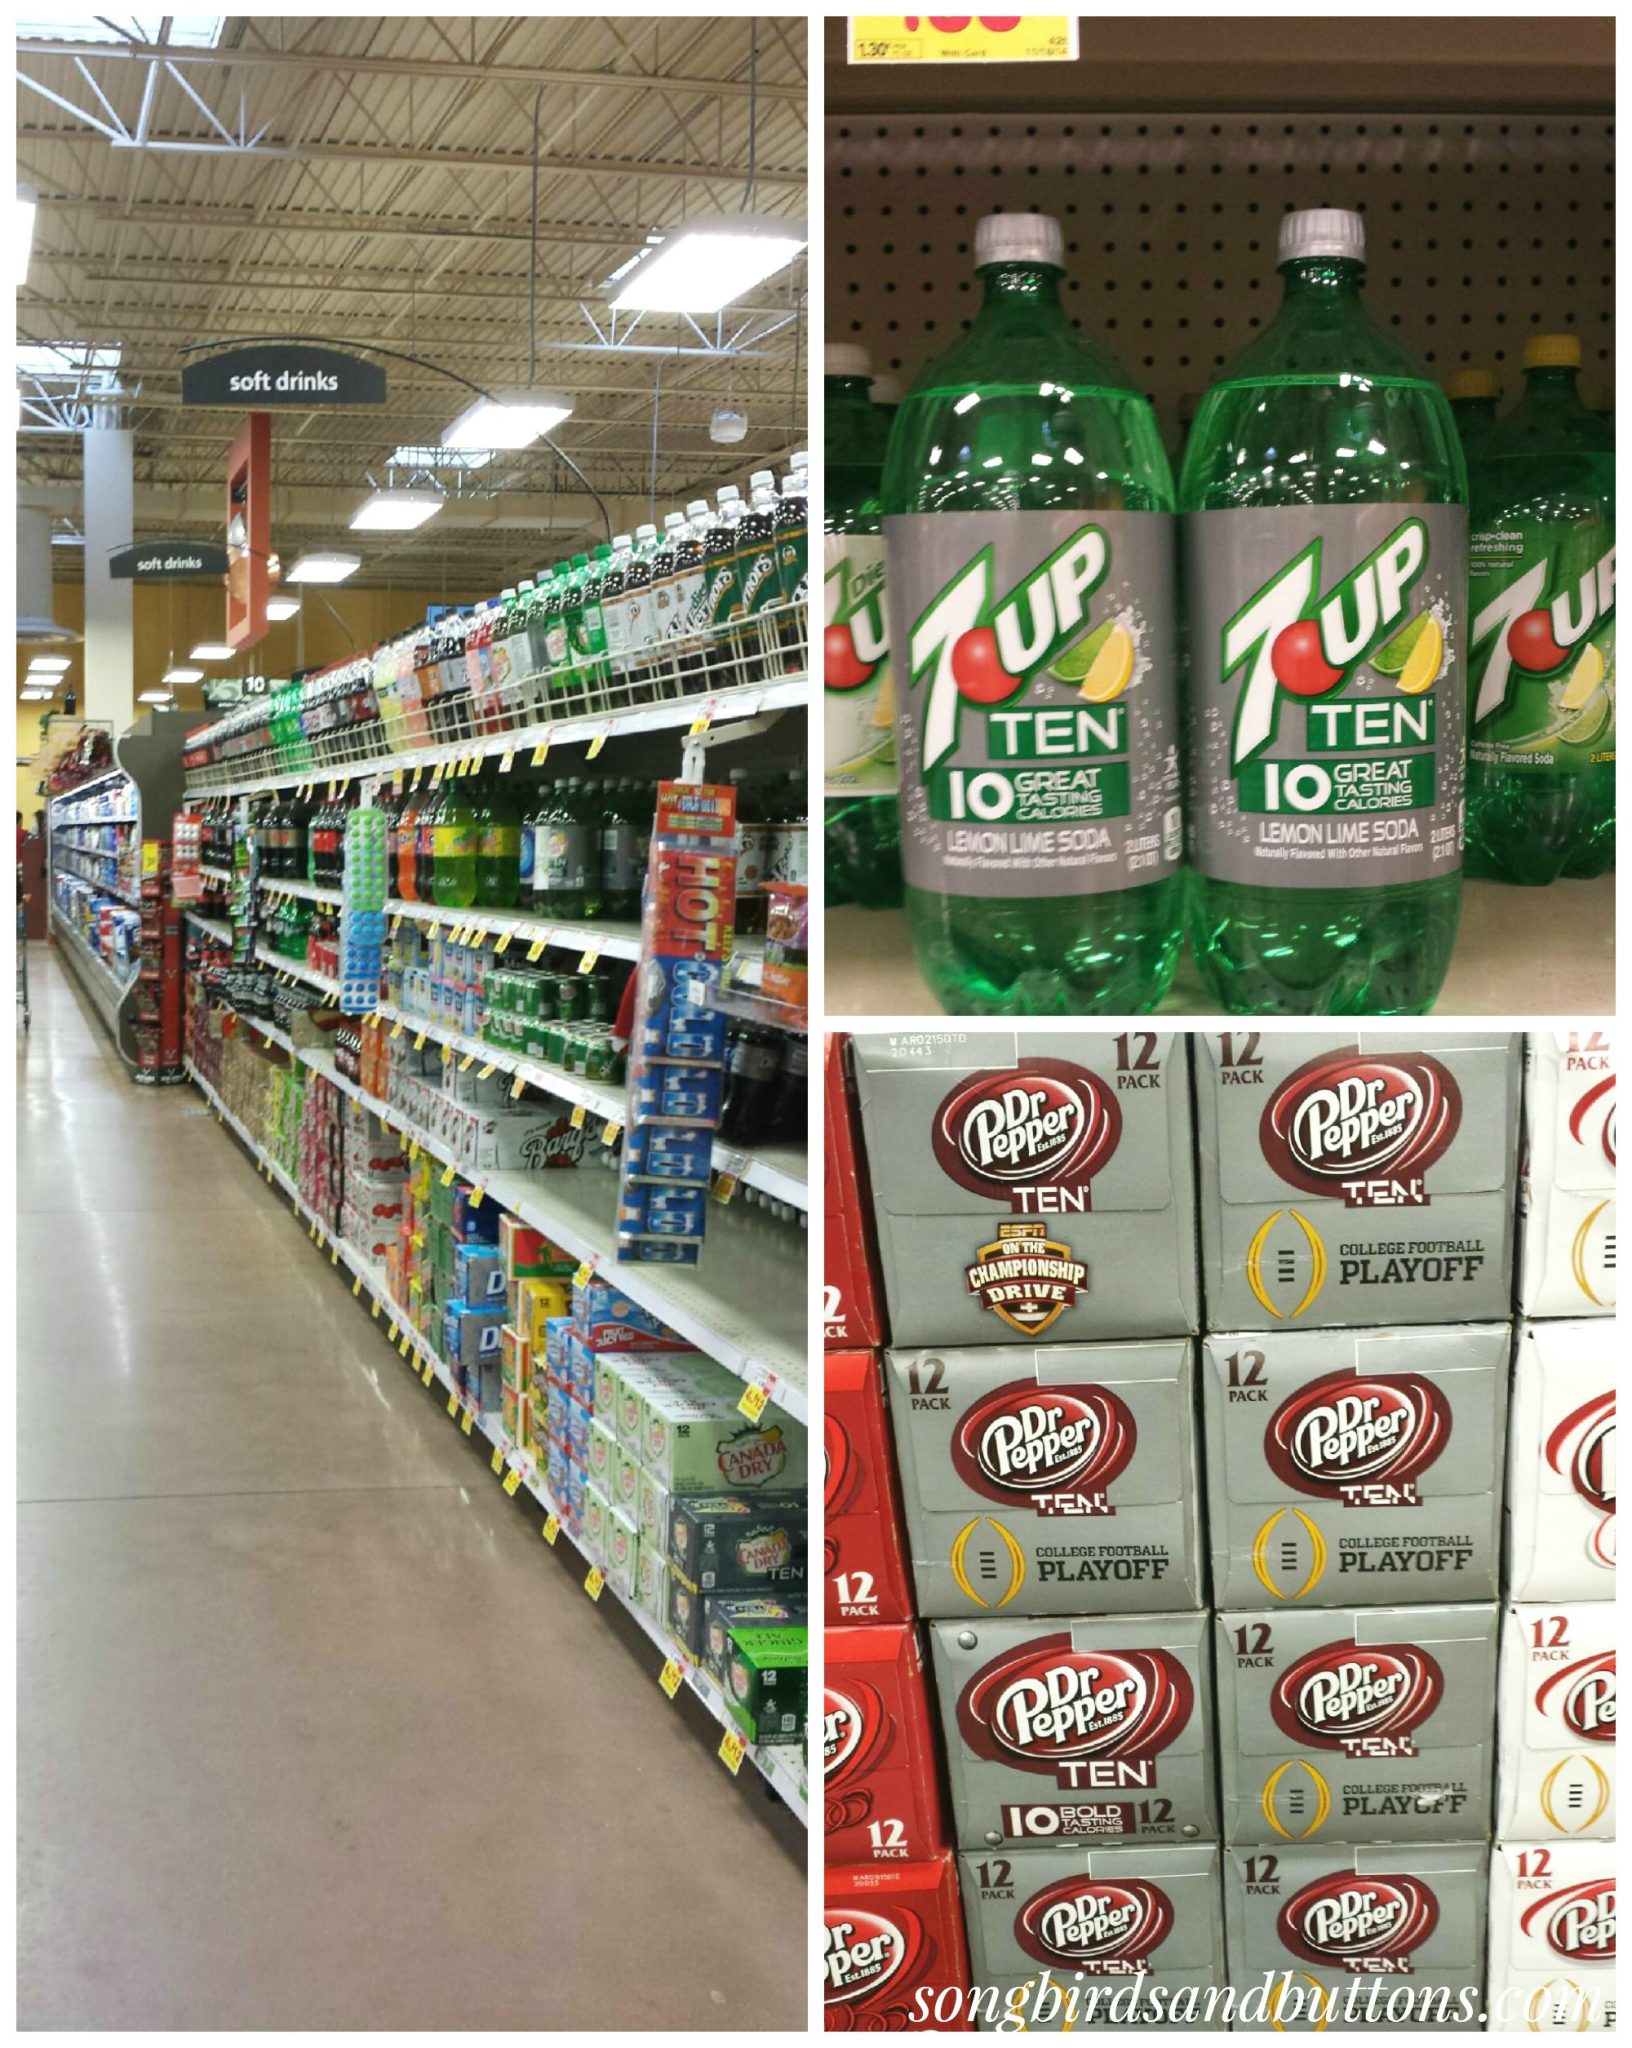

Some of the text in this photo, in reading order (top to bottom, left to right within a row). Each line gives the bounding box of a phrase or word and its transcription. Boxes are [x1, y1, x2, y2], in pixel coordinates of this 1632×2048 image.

[229, 369, 339, 393] soft drinks
[1470, 542, 1524, 554] refreshing
[136, 555, 202, 572] soft drinks
[852, 560, 884, 594] Die
[245, 676, 265, 693] 10
[989, 707, 1119, 756] TEN
[1310, 699, 1427, 747] TEN
[1500, 752, 1533, 764] Flavored
[1534, 752, 1555, 765] Soda
[1015, 768, 1102, 792] GREAT
[1333, 759, 1412, 783] GREAT
[949, 770, 1015, 821] 10
[1015, 788, 1102, 807] TASTING
[1264, 763, 1332, 811] 10
[1334, 780, 1412, 798] TASTING
[1016, 804, 1103, 821] CALORIES
[1334, 795, 1413, 812] CALORIES
[946, 827, 1112, 854] LEMON LIME SODA
[1259, 818, 1420, 844] LEMON LIME SODA
[1254, 842, 1424, 860] Naturally Flavored With Other Natural Flavors
[673, 856, 721, 951] HOT
[1112, 1032, 1160, 1071] 12
[1217, 1032, 1264, 1068] 12
[1567, 1056, 1610, 1071] PACK
[1116, 1074, 1161, 1090] PACK
[1221, 1070, 1265, 1086] PACK
[1002, 1089, 1046, 1127] Dr
[1339, 1076, 1385, 1119] Dr
[963, 1098, 1075, 1167] Pepper
[1293, 1088, 1415, 1162] Pepper
[1370, 1125, 1403, 1145] Est.1885
[1012, 1186, 1085, 1213] TEN
[1341, 1180, 1422, 1205] TEN
[1000, 1223, 1045, 1237] ESPN
[1002, 1241, 1046, 1255] ON THE
[1339, 1240, 1485, 1256] COLLEGE FOOTBALL
[968, 1257, 1086, 1289] CHAMPIONSHIP
[1339, 1256, 1484, 1286] PLAYOFF
[986, 1283, 1067, 1304] DRIVE
[906, 1357, 950, 1396] 12
[1223, 1349, 1268, 1388] 12
[911, 1397, 951, 1411] PACK
[1228, 1389, 1269, 1403] PACK
[1018, 1405, 1064, 1442] Dr
[1337, 1396, 1381, 1436] Dr
[675, 1424, 691, 1434] 12
[1294, 1406, 1408, 1468] Pepper
[718, 1441, 788, 1472] CANADA
[981, 1415, 1091, 1476] Pepper
[739, 1457, 772, 1479] DRY
[1030, 1493, 1107, 1515] TEN
[1339, 1484, 1416, 1506] TEN
[703, 1523, 716, 1534] 12
[1035, 1544, 1169, 1558] COLLEGE FOOTBALL
[1338, 1535, 1474, 1549] COLLEGE FOOTBALL
[753, 1552, 780, 1569] DRY
[1037, 1558, 1169, 1582] PLAYOFF
[1338, 1549, 1474, 1573] PLAYOFF
[767, 1567, 804, 1580] TEN
[832, 1571, 879, 1605] 12
[840, 1603, 880, 1617] PACK
[1234, 1621, 1274, 1656] 12
[1530, 1615, 1571, 1649] 12
[1237, 1656, 1274, 1669] PACK
[1531, 1649, 1571, 1663] PACK
[761, 1669, 777, 1681] 12
[1044, 1664, 1100, 1708] Dr
[1337, 1661, 1379, 1697] Dr
[1300, 1670, 1403, 1724] Pepper
[996, 1677, 1137, 1746] Pepper
[1087, 1711, 1125, 1732] Est.1885
[1340, 1737, 1413, 1757] TEN
[1058, 1759, 1148, 1788] TEN
[1342, 1784, 1400, 1796] COLLEGE
[1008, 1805, 1060, 1838] 10
[1059, 1805, 1122, 1819] BOLD
[1060, 1817, 1124, 1827] TASTING
[1137, 1797, 1176, 1824] 12
[866, 1818, 910, 1849] 12
[1062, 1825, 1124, 1836] CALORIES
[1140, 1823, 1177, 1836] PACK
[873, 1847, 910, 1860] PACK
[1516, 1848, 1553, 1878] 12
[975, 1859, 1015, 1890] 12
[1242, 1854, 1281, 1883] 12
[980, 1890, 1015, 1900] PACK
[1246, 1884, 1281, 1895] PACK
[1516, 1878, 1553, 1890] PACK
[1074, 1895, 1111, 1922] Dr
[1340, 1890, 1377, 1917] Dr
[1041, 1902, 1137, 1949] Pepper
[1304, 1896, 1401, 1944] Pepper
[844, 1963, 882, 1982] Est.1885
